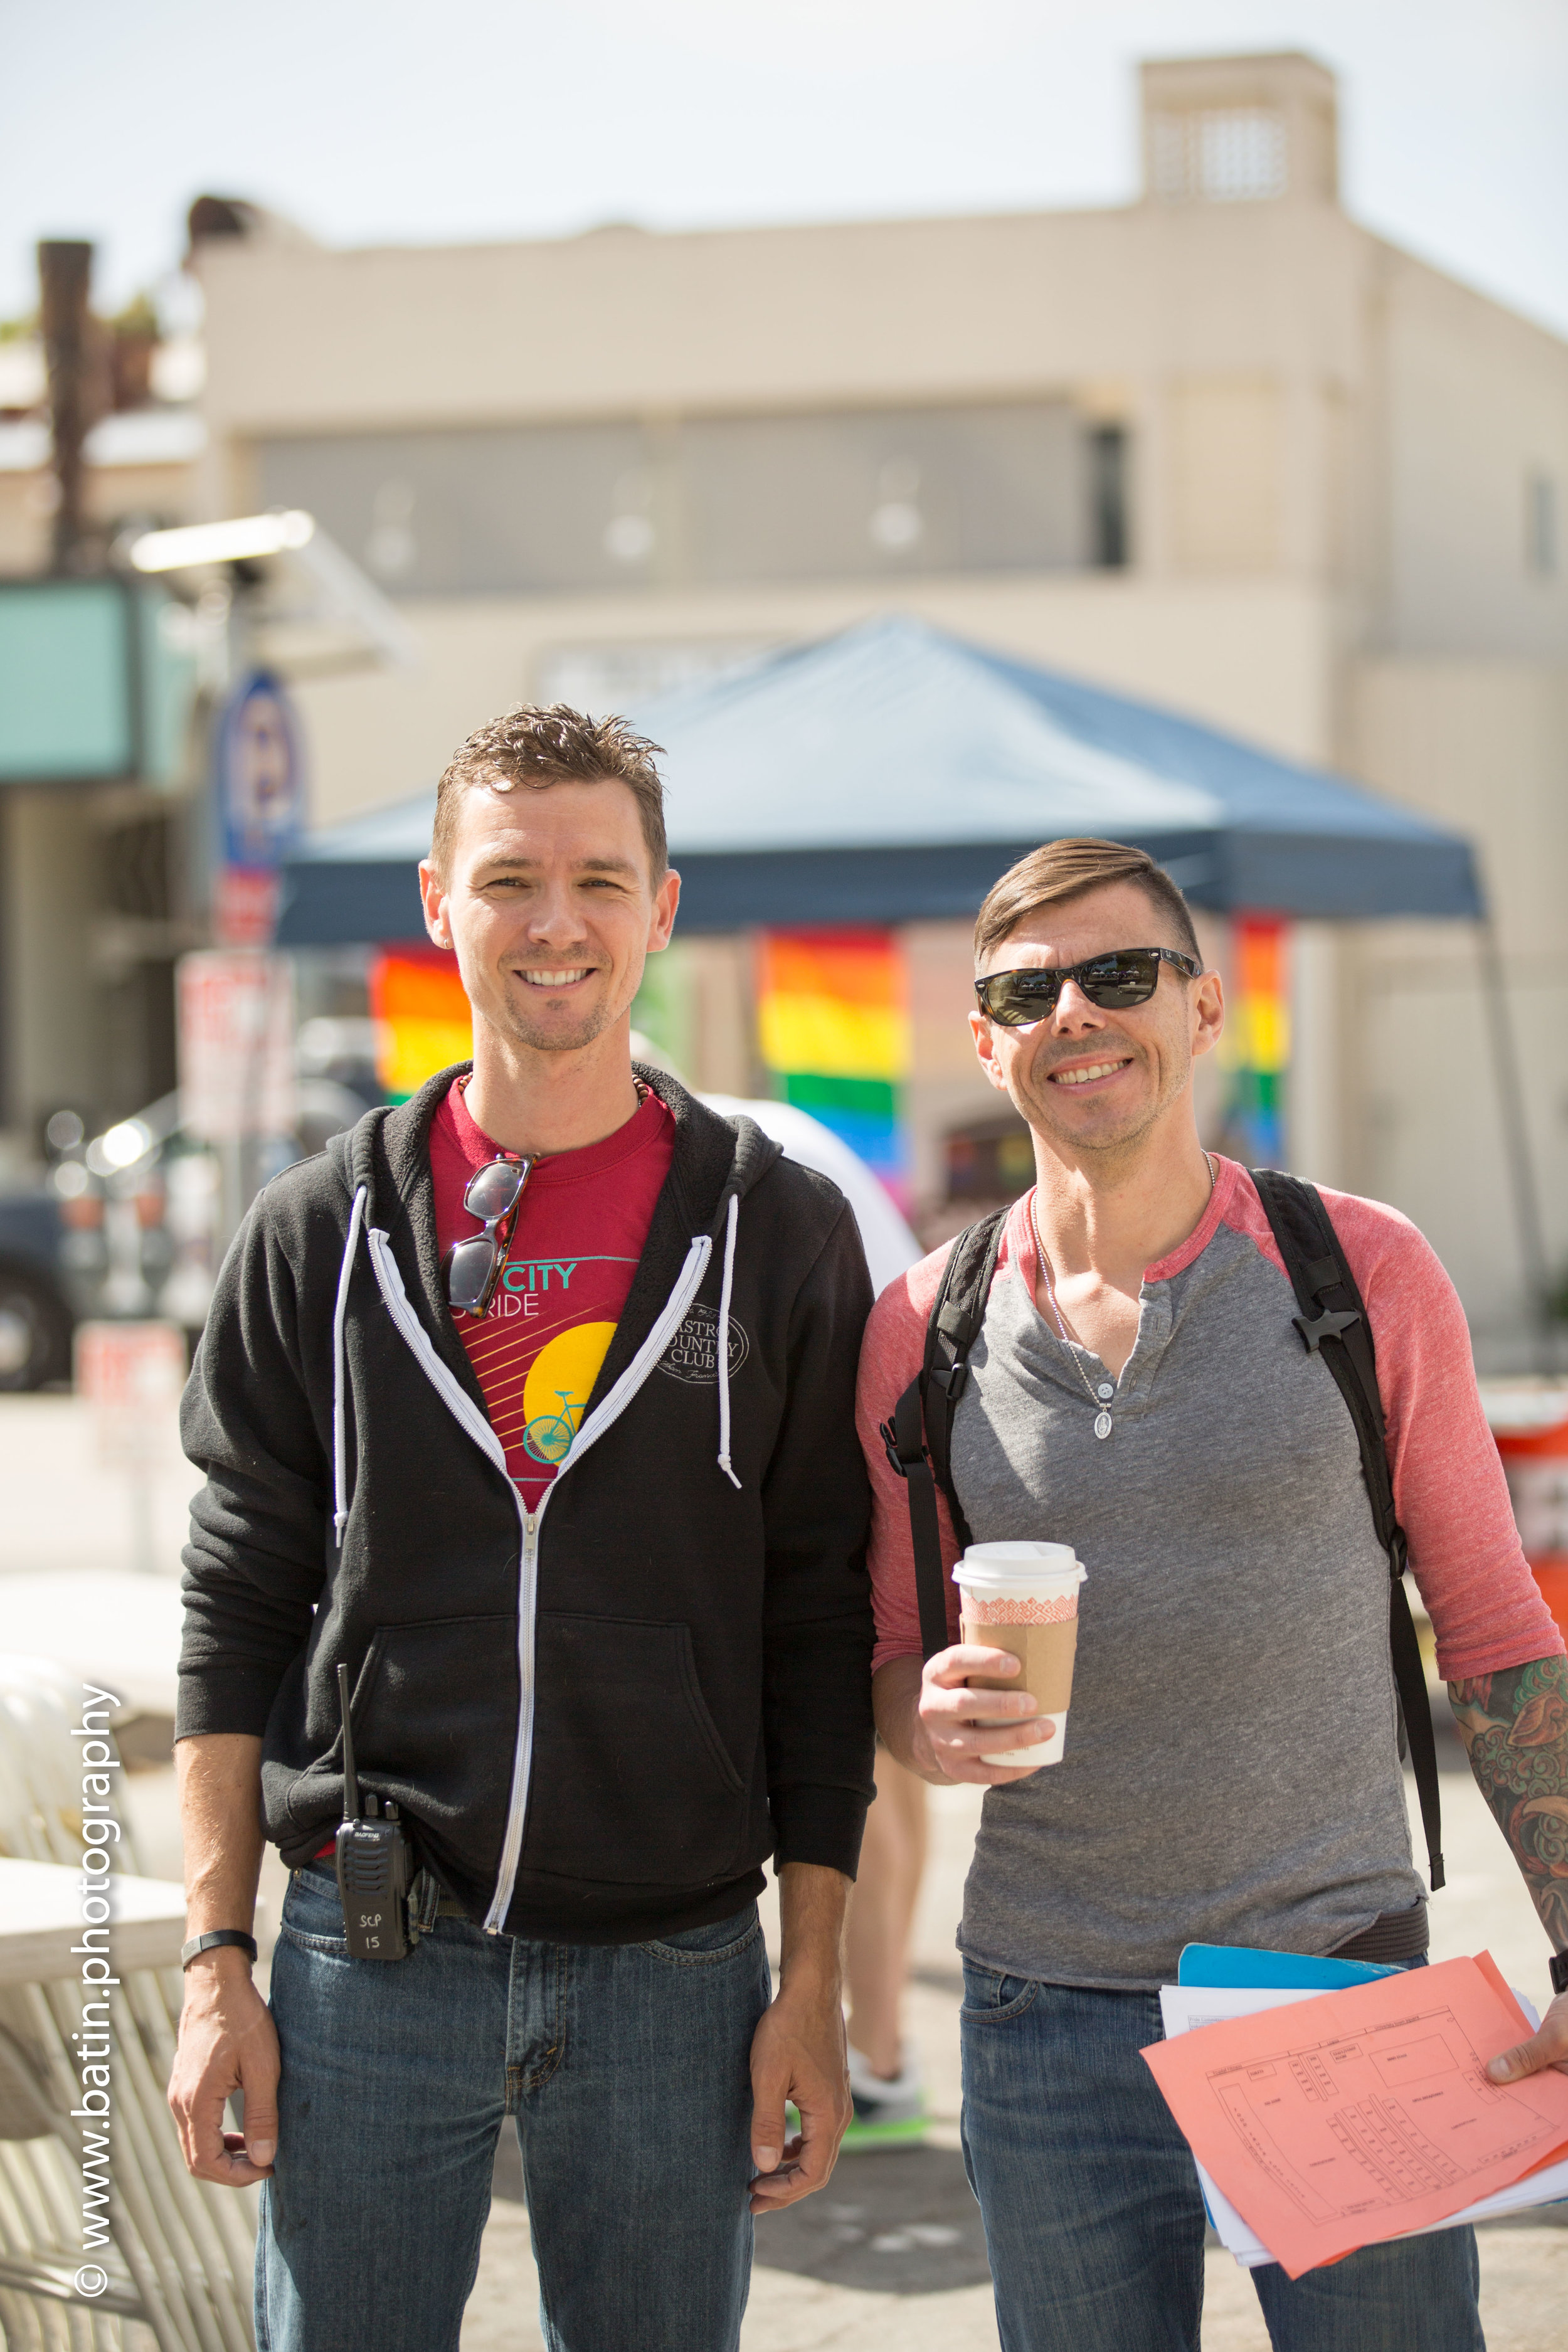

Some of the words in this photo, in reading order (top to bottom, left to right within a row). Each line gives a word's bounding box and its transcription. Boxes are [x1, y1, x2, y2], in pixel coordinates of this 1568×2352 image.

[503, 1263, 577, 1292] CITY
[678, 1320, 729, 1338] ASTR
[669, 1335, 739, 1357] OUNTY
[671, 1348, 715, 1369] CLUB
[359, 1914, 382, 1927] SCP
[366, 1936, 380, 1949] 15
